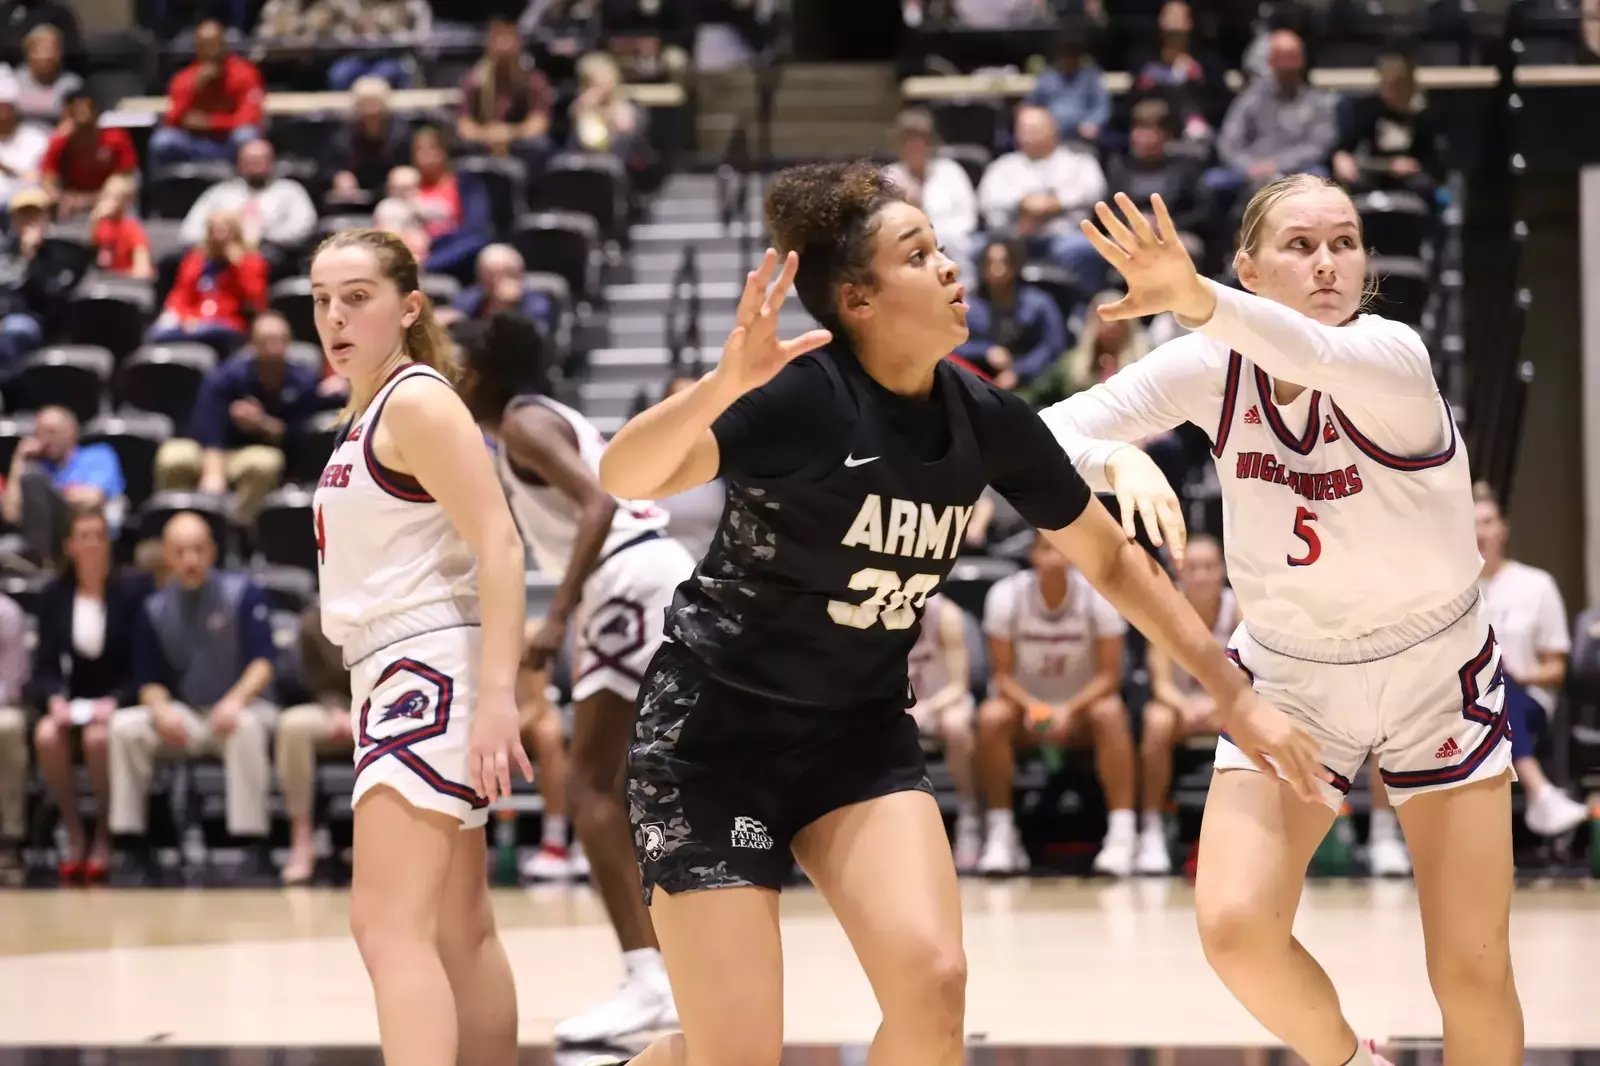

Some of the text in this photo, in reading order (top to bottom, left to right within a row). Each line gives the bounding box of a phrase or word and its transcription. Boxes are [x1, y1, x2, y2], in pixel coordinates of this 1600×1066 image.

[841, 493, 974, 560] ARMY
[1287, 506, 1322, 567] 5
[827, 567, 941, 631] 30
[1435, 749, 1462, 759] adidas
